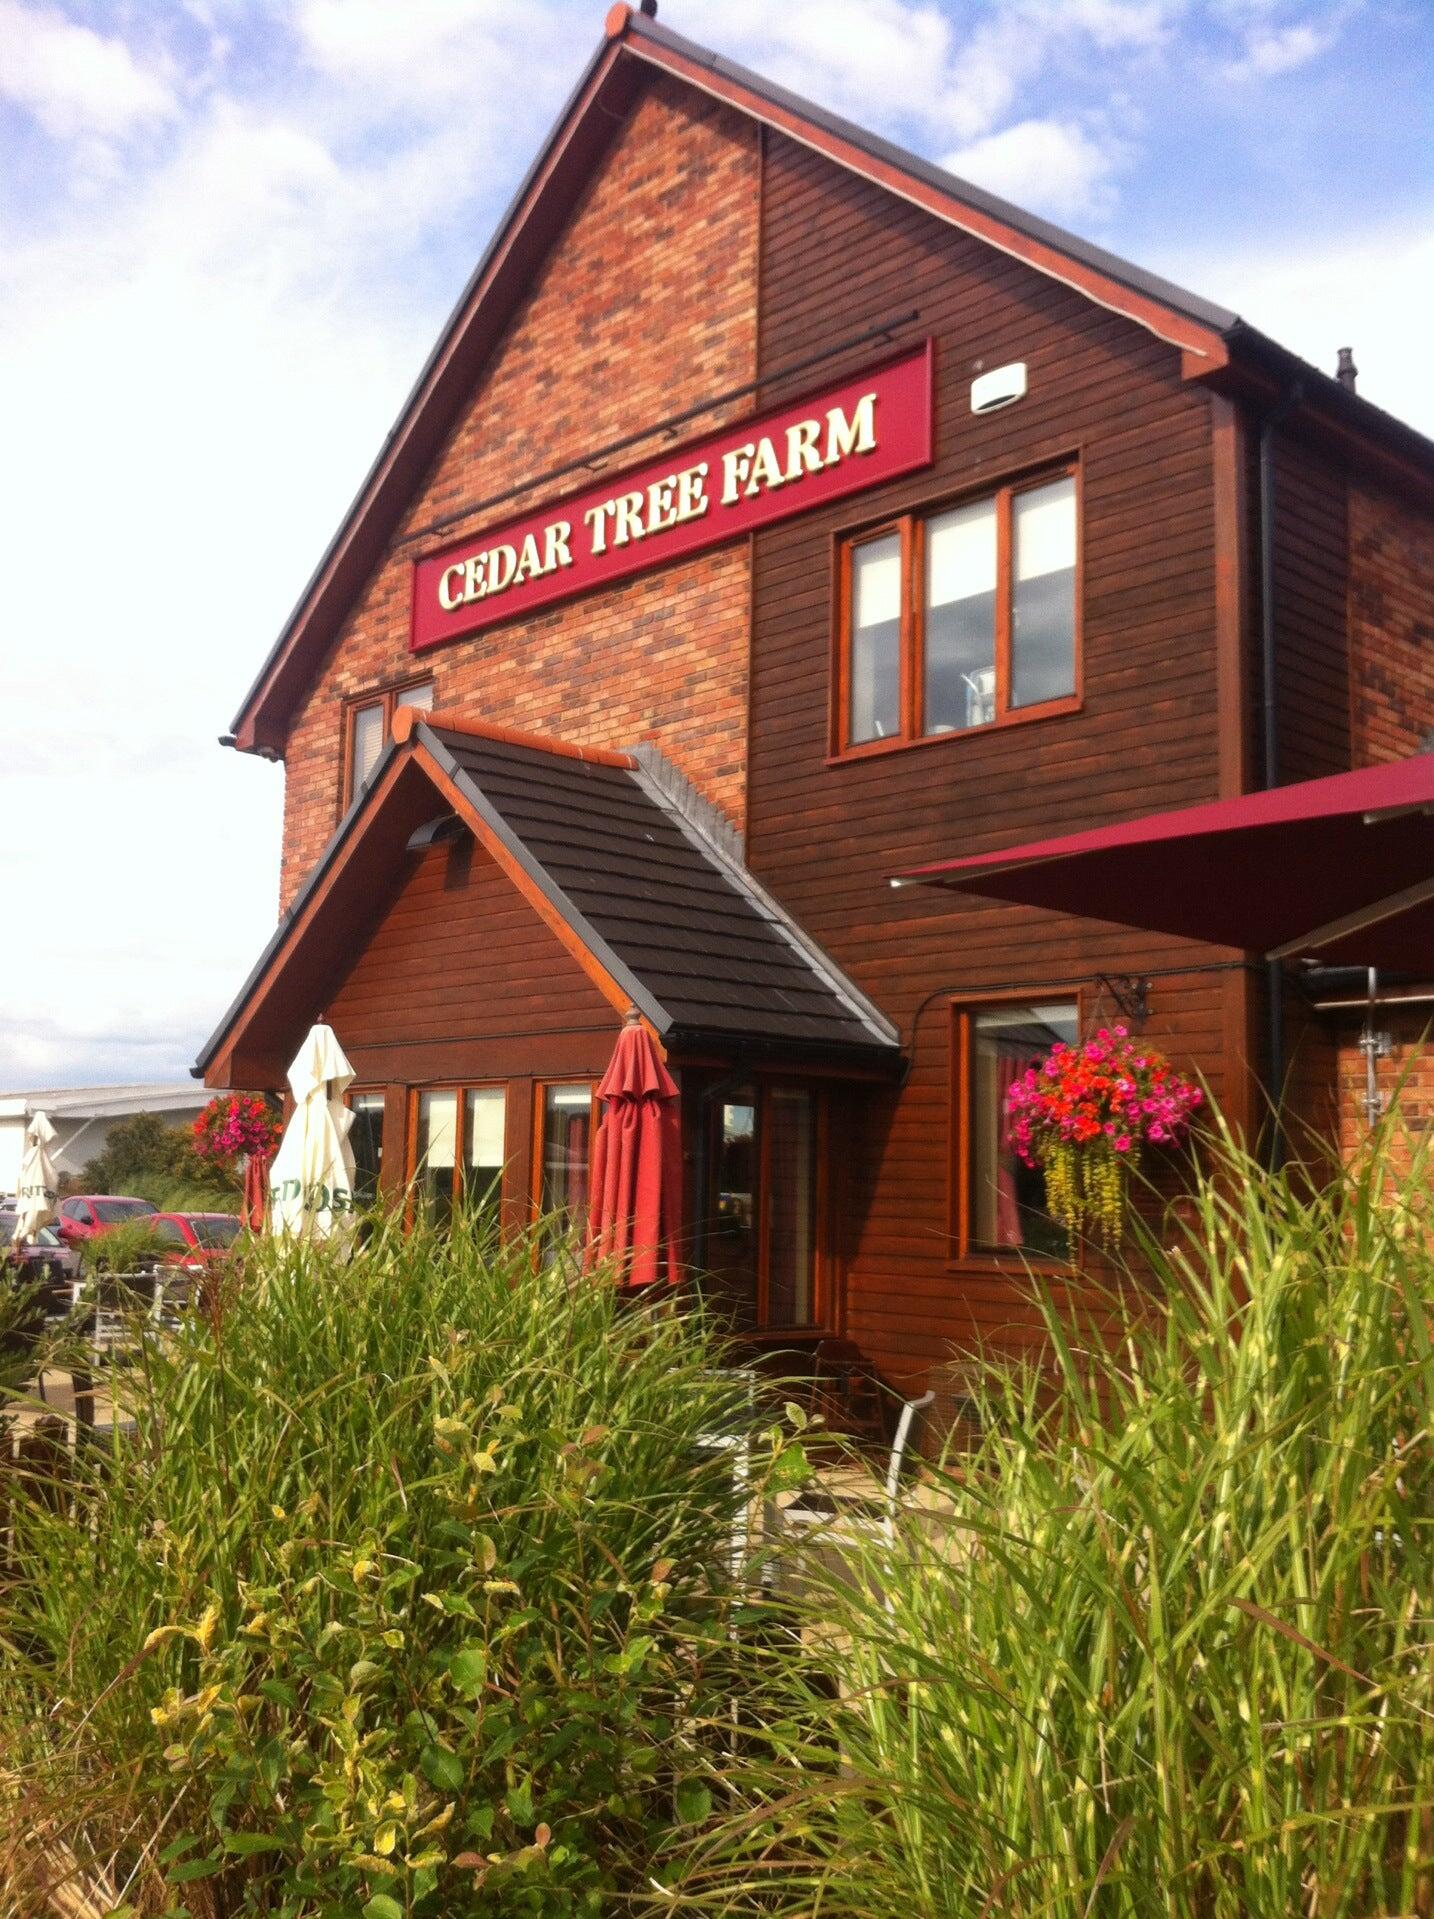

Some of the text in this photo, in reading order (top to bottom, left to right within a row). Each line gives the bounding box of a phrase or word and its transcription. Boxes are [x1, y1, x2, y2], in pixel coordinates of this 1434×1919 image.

[437, 393, 878, 611] CEDAR TREE FARM
